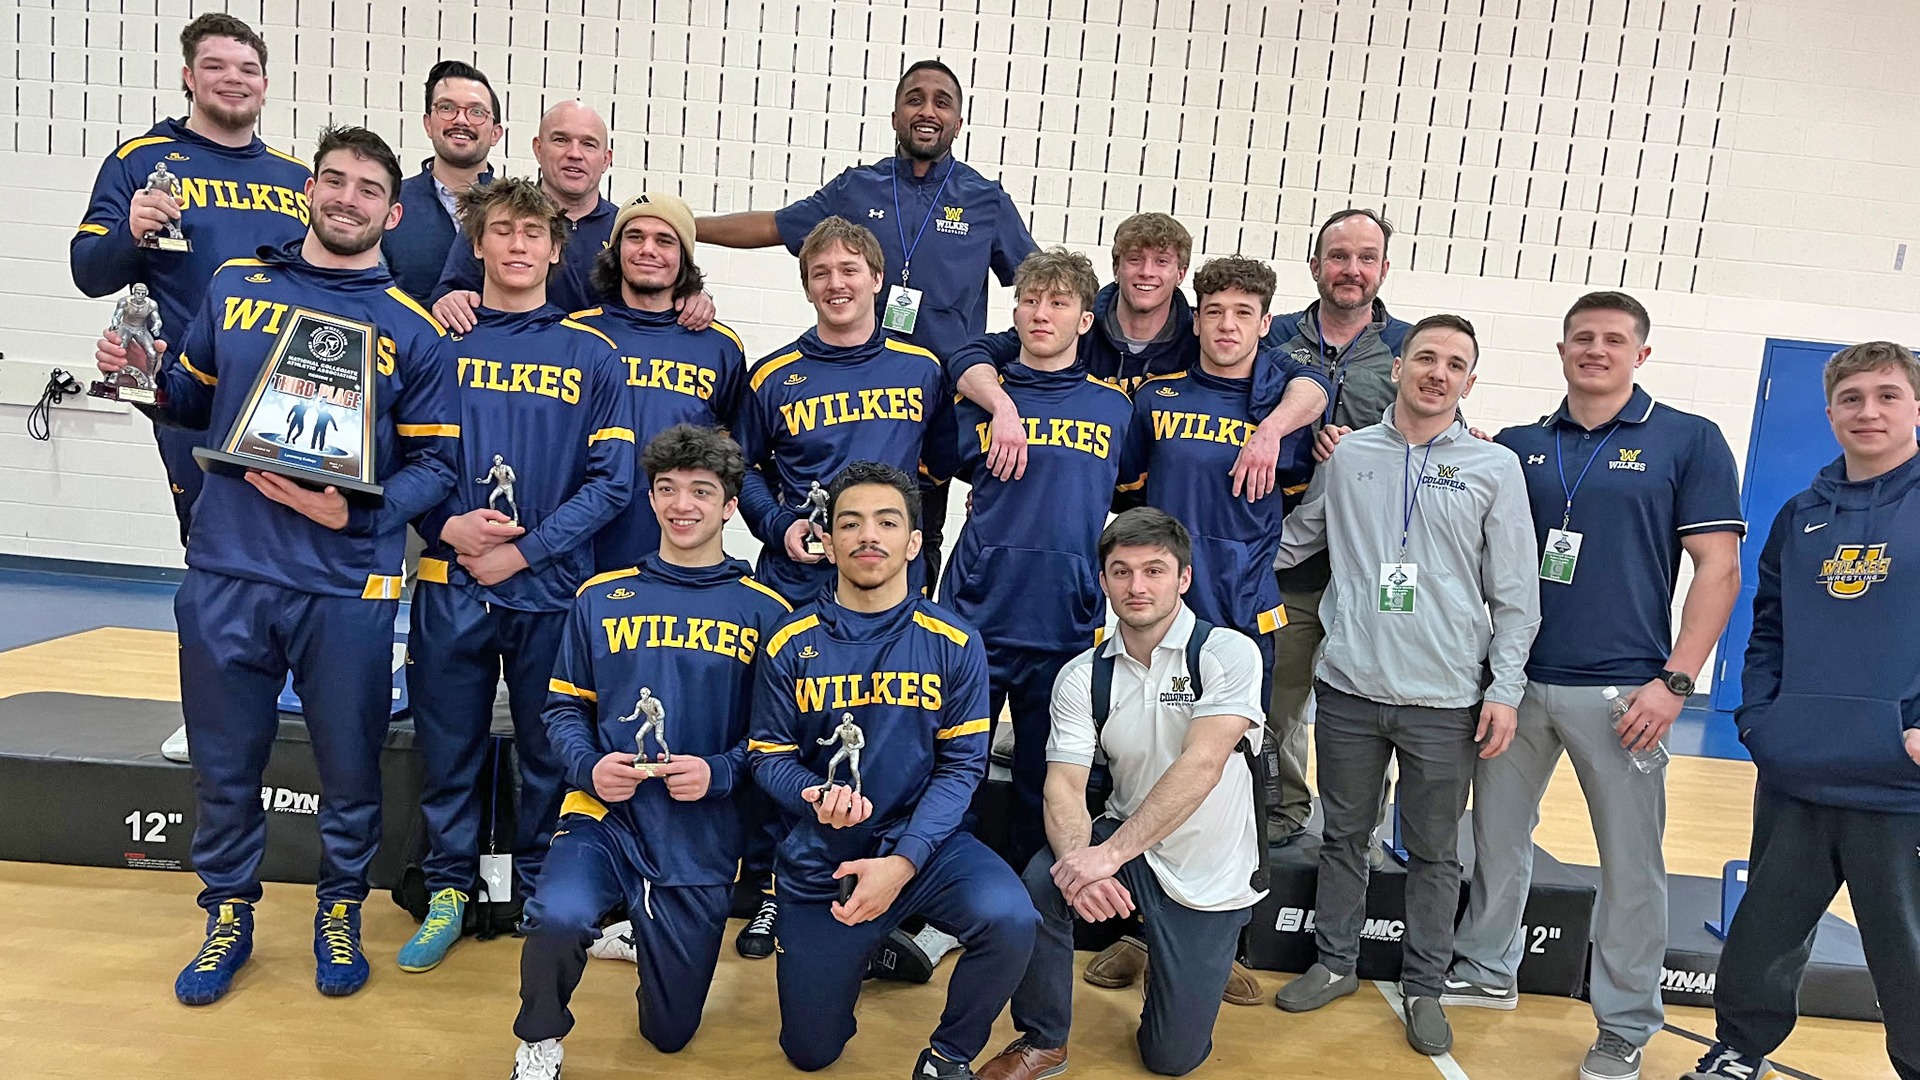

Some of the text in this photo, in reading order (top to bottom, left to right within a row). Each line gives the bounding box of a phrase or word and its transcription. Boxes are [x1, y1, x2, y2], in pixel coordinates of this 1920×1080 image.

[935, 218, 969, 232] WILKES
[286, 360, 358, 381] ATHLETIC ASSOCIATION
[287, 355, 359, 377] NATIONAL COLLEGIATE
[620, 356, 717, 400] LKES
[779, 387, 924, 437] WILKES
[1619, 448, 1643, 462] W
[1437, 463, 1460, 479] W
[1608, 460, 1646, 472] WILKES
[1422, 475, 1466, 491] COLONELS
[1821, 559, 1889, 577] WILKES
[602, 614, 759, 665] WILKES
[796, 671, 942, 713] WILKES
[1160, 692, 1195, 702] COLONEL
[125, 810, 183, 843] 12"
